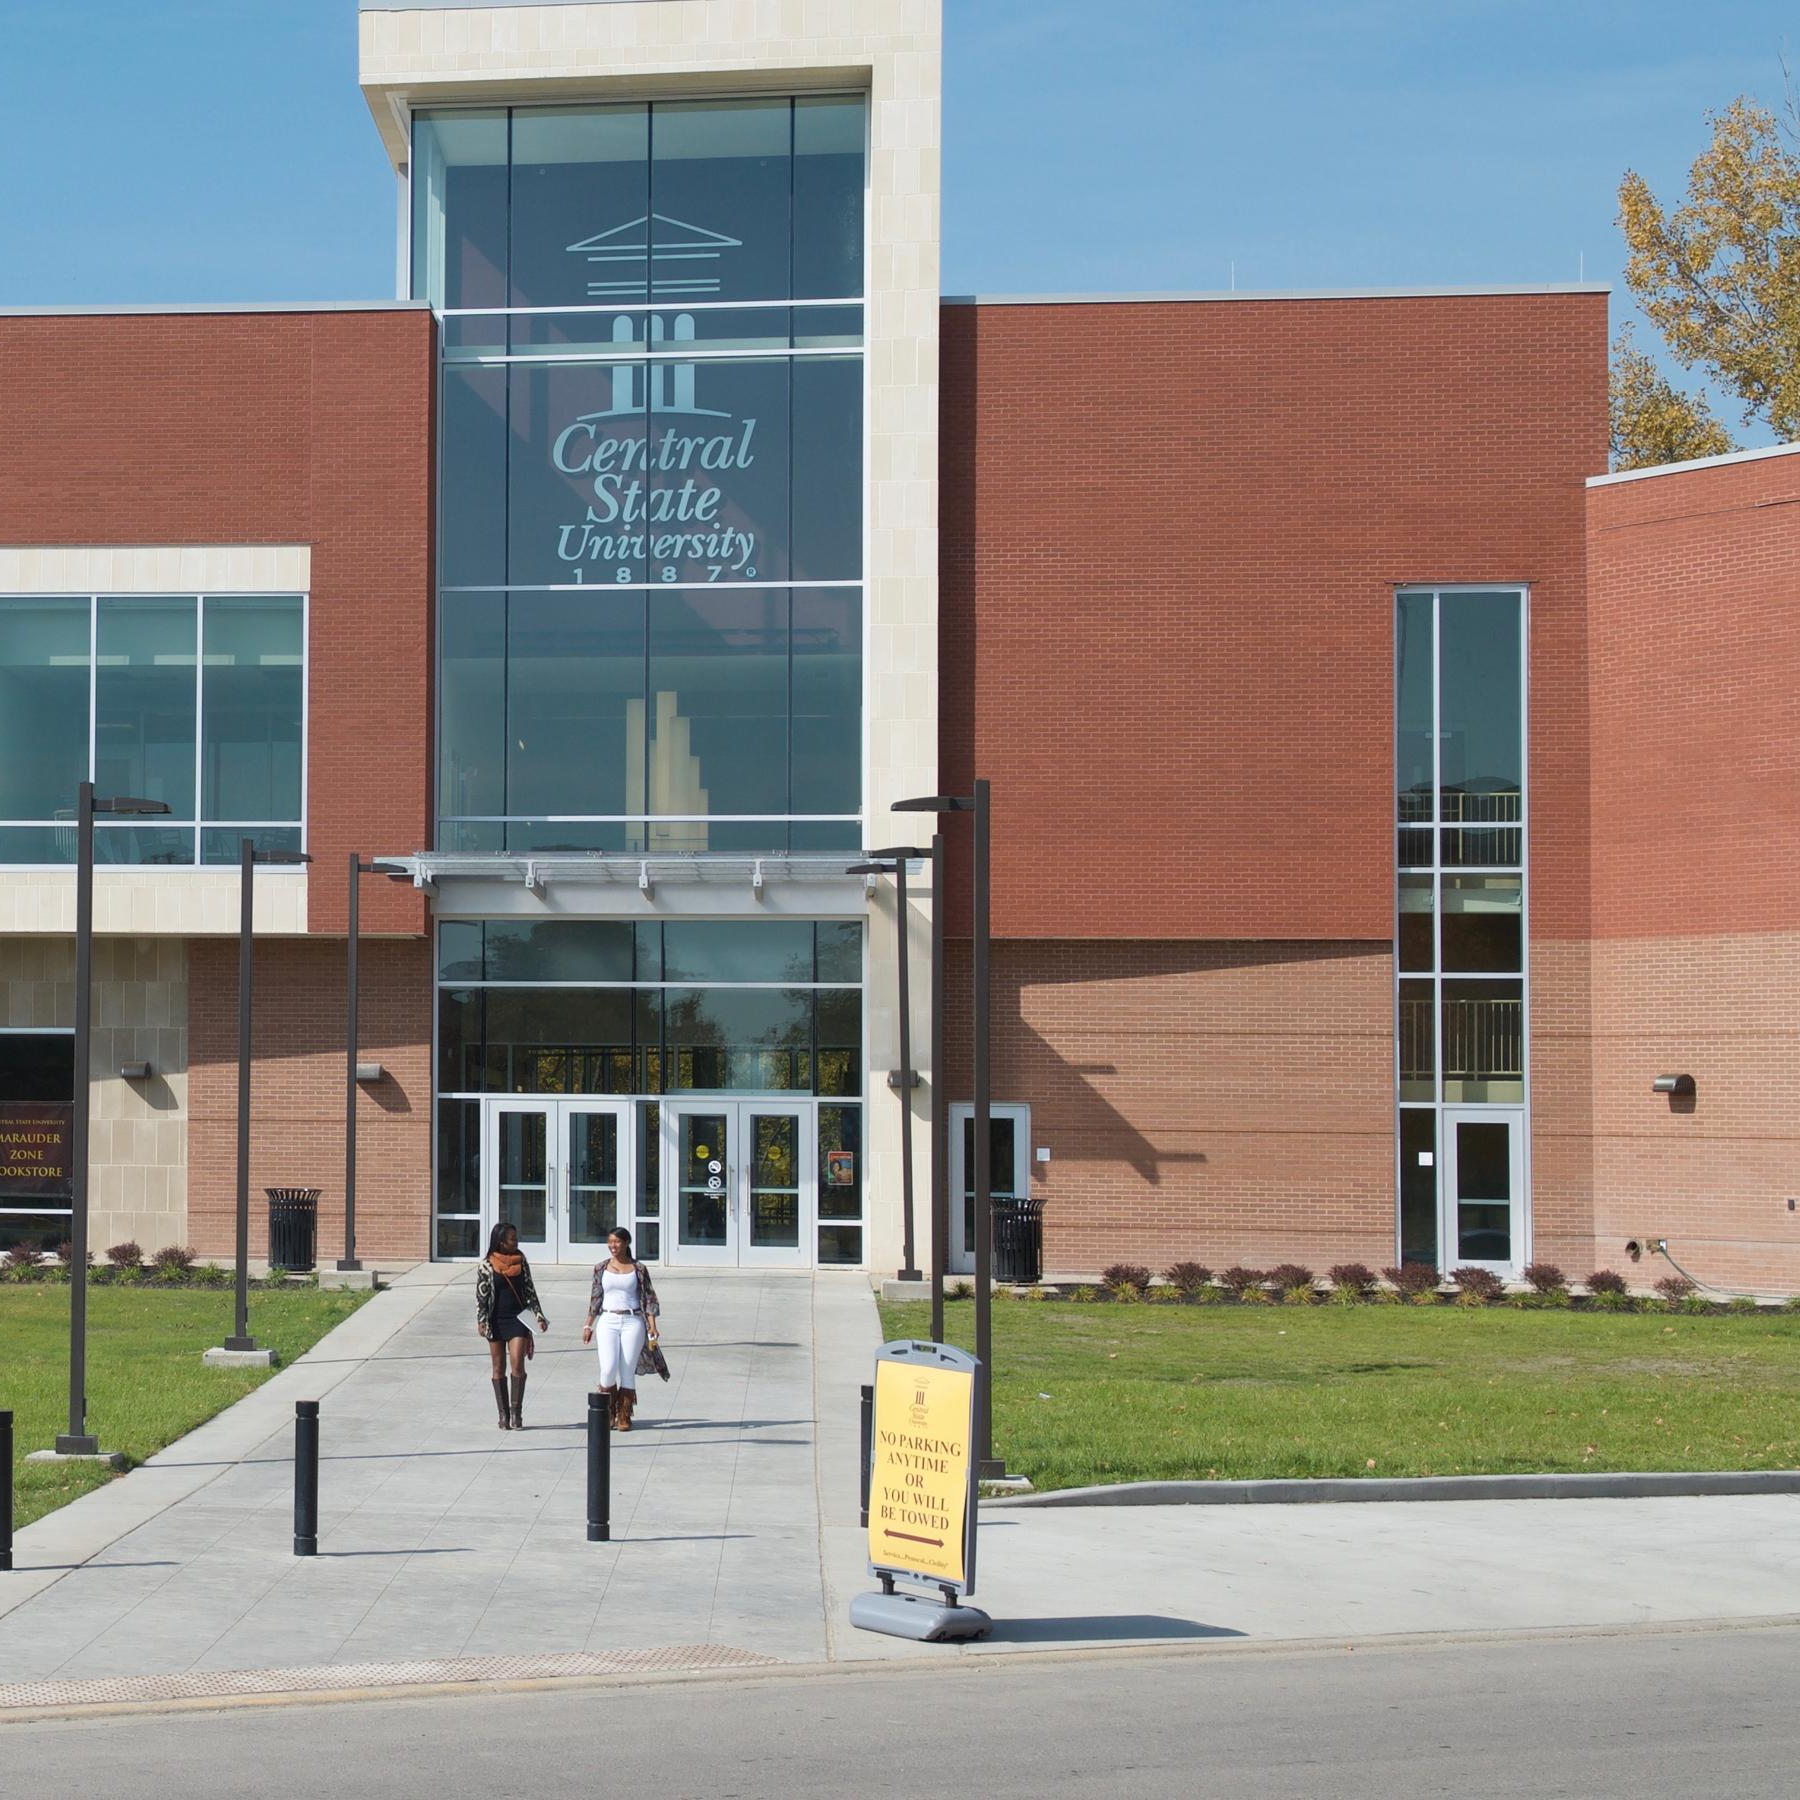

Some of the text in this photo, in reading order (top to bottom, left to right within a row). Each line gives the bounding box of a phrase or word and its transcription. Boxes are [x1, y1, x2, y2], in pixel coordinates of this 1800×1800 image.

[552, 419, 756, 473] Central
[586, 473, 721, 523] State
[557, 522, 754, 570] University
[9, 1149, 44, 1160] ZONE
[880, 1429, 961, 1457] NO PARKING
[886, 1450, 949, 1474] ANYTIME
[905, 1472, 924, 1489] OR
[883, 1486, 950, 1512] YOU WILL
[880, 1504, 950, 1531] BE TOWED
